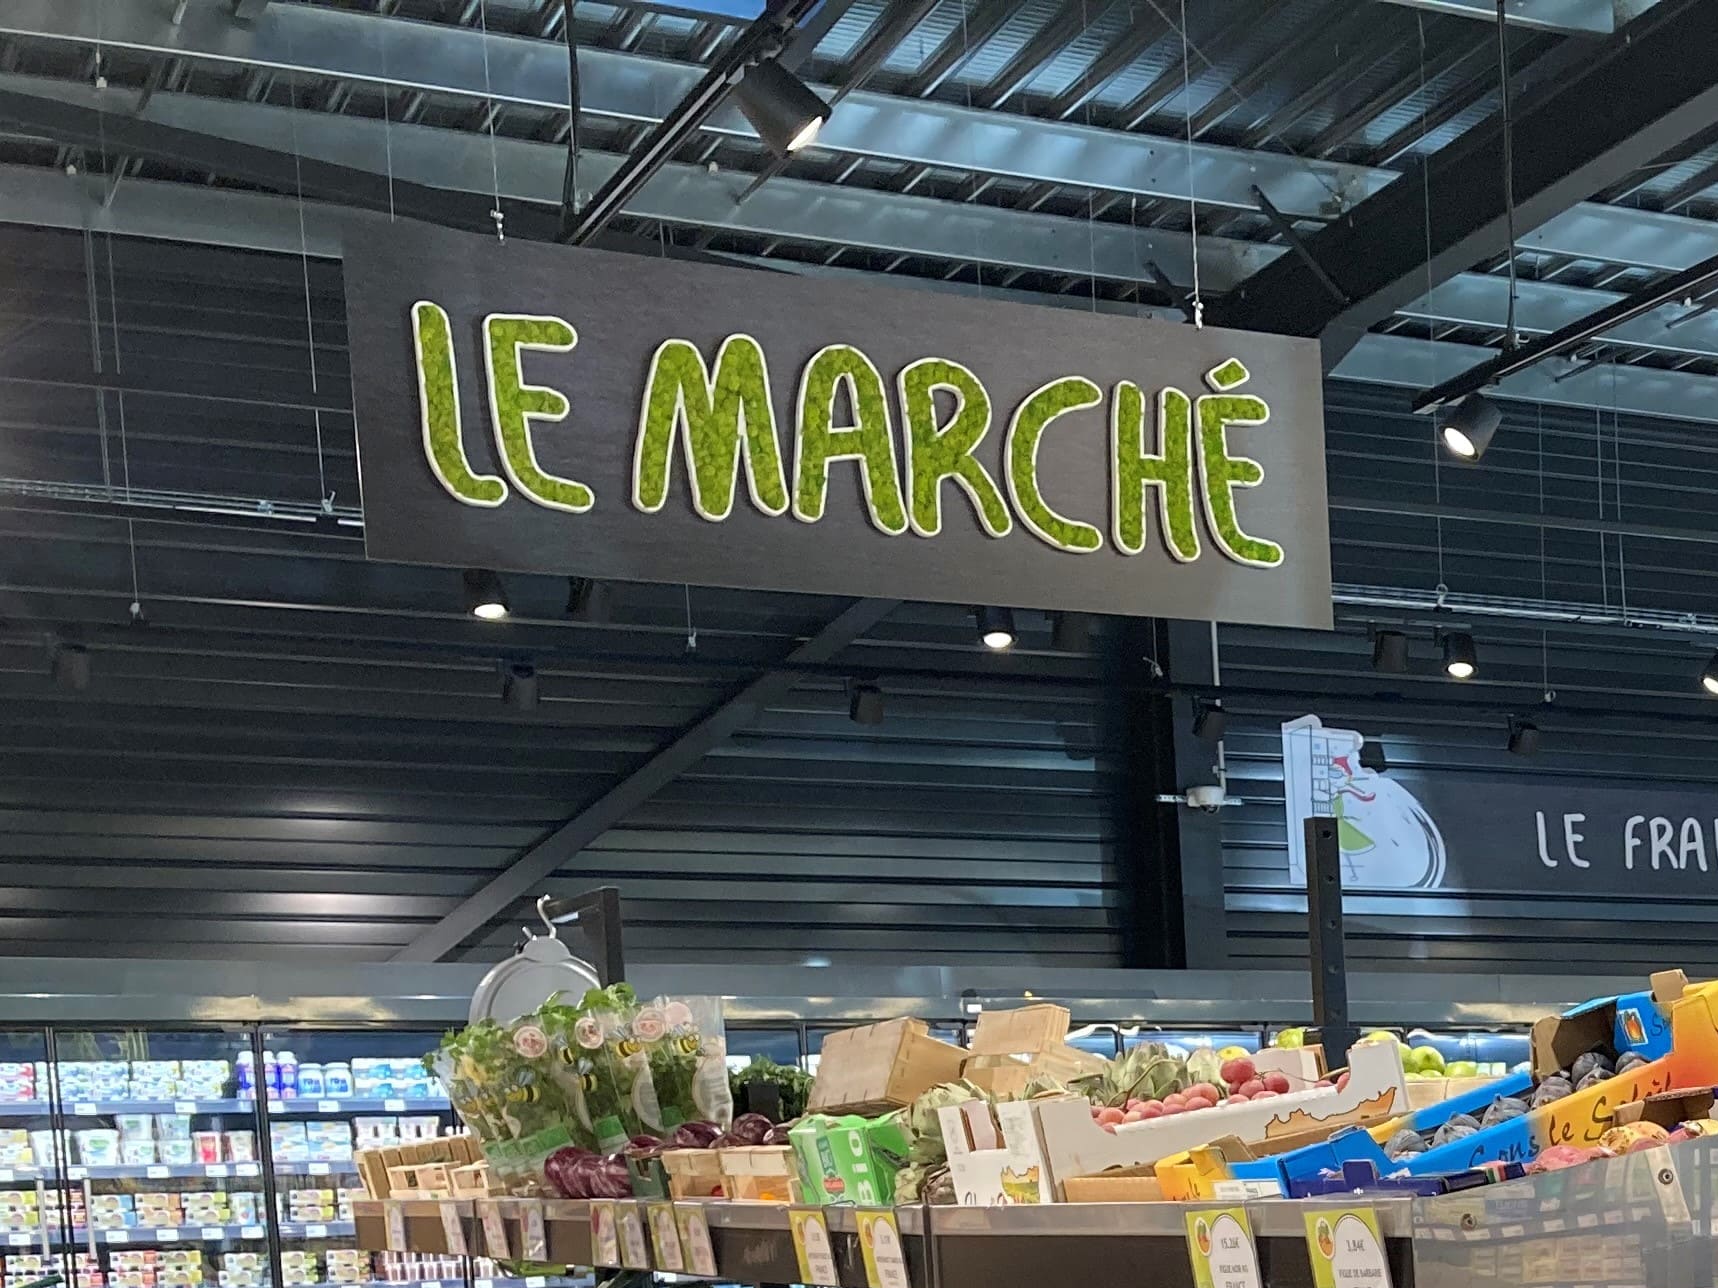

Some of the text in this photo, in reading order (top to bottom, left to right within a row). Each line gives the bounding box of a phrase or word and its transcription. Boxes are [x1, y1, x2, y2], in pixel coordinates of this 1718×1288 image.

[411, 300, 1285, 569] LE MARCHÉ
[1535, 810, 1591, 869] LE
[848, 1129, 877, 1206] BIO
